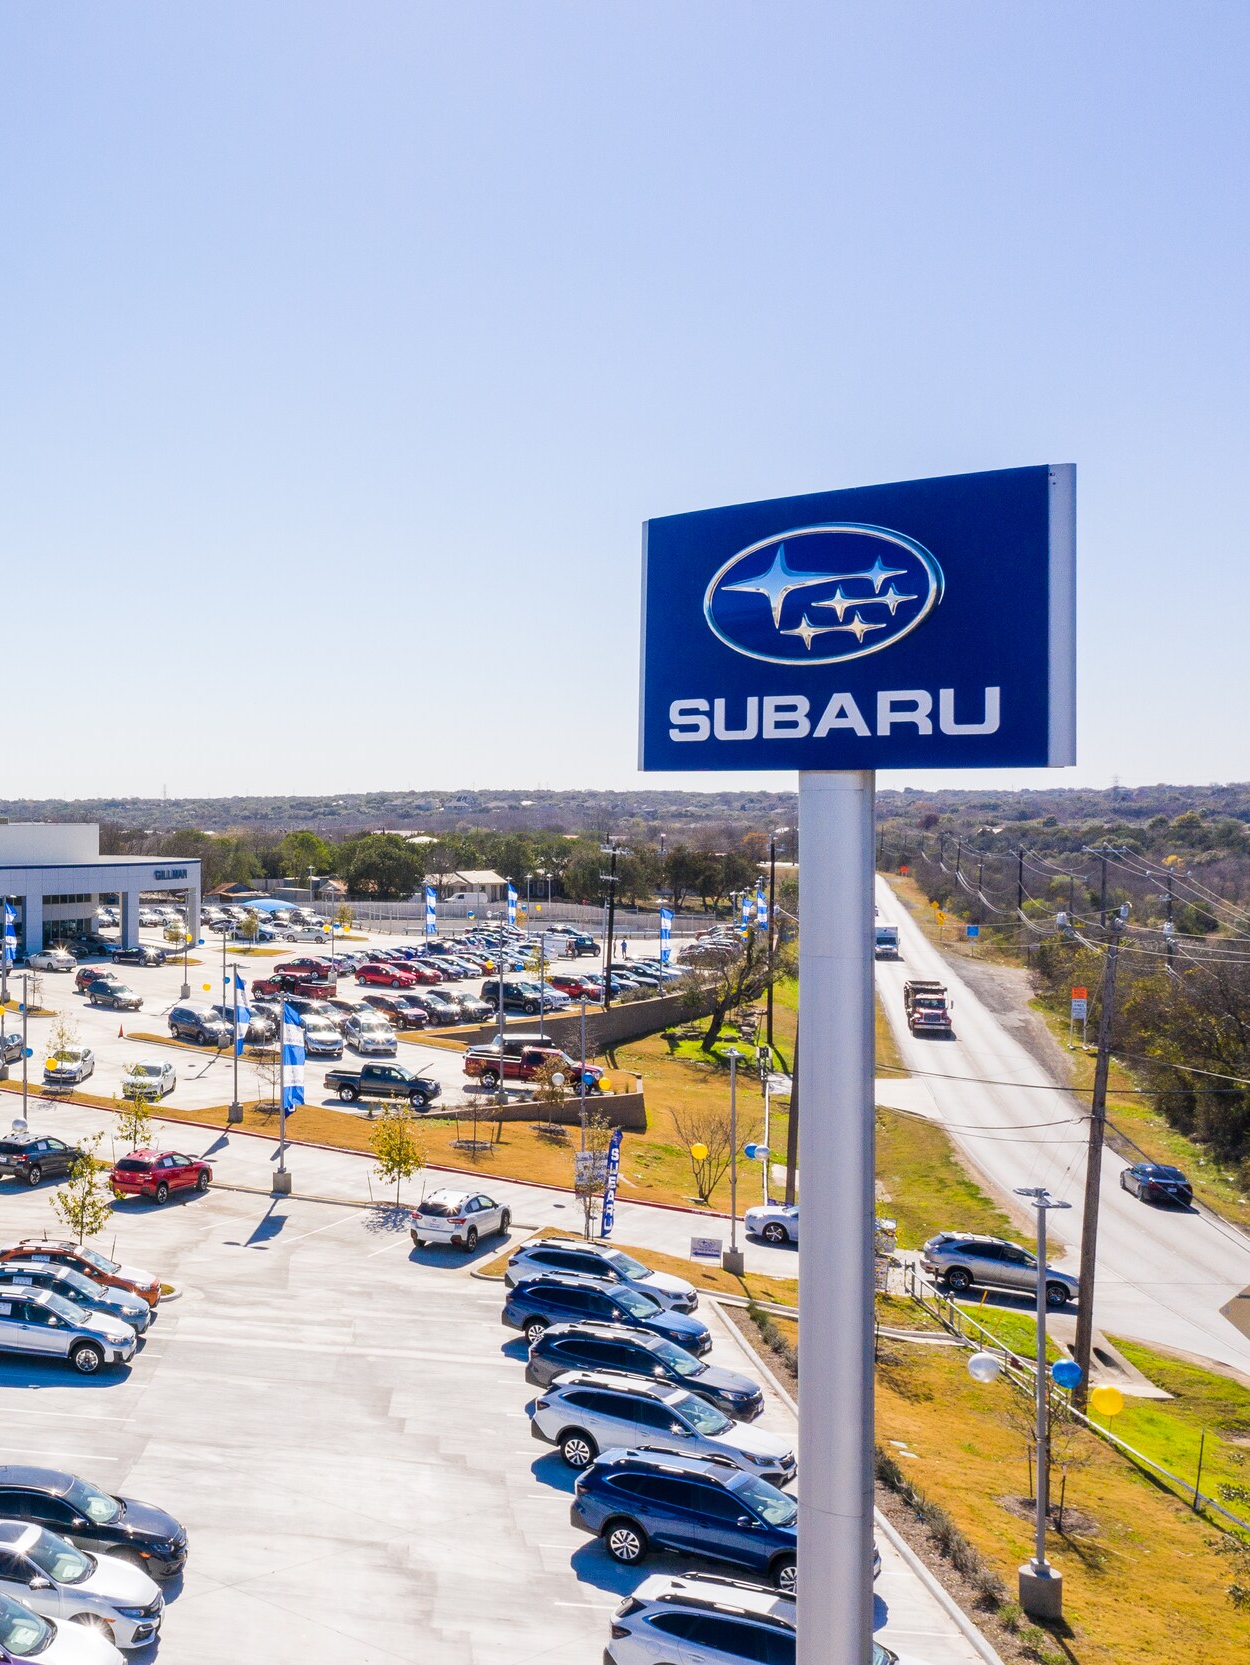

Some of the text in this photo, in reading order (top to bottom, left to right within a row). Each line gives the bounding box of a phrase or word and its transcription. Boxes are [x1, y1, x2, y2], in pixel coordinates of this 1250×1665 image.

[669, 686, 1001, 742] SUBARU
[154, 869, 188, 880] GILLMAN
[603, 1148, 620, 1231] SUBARU
